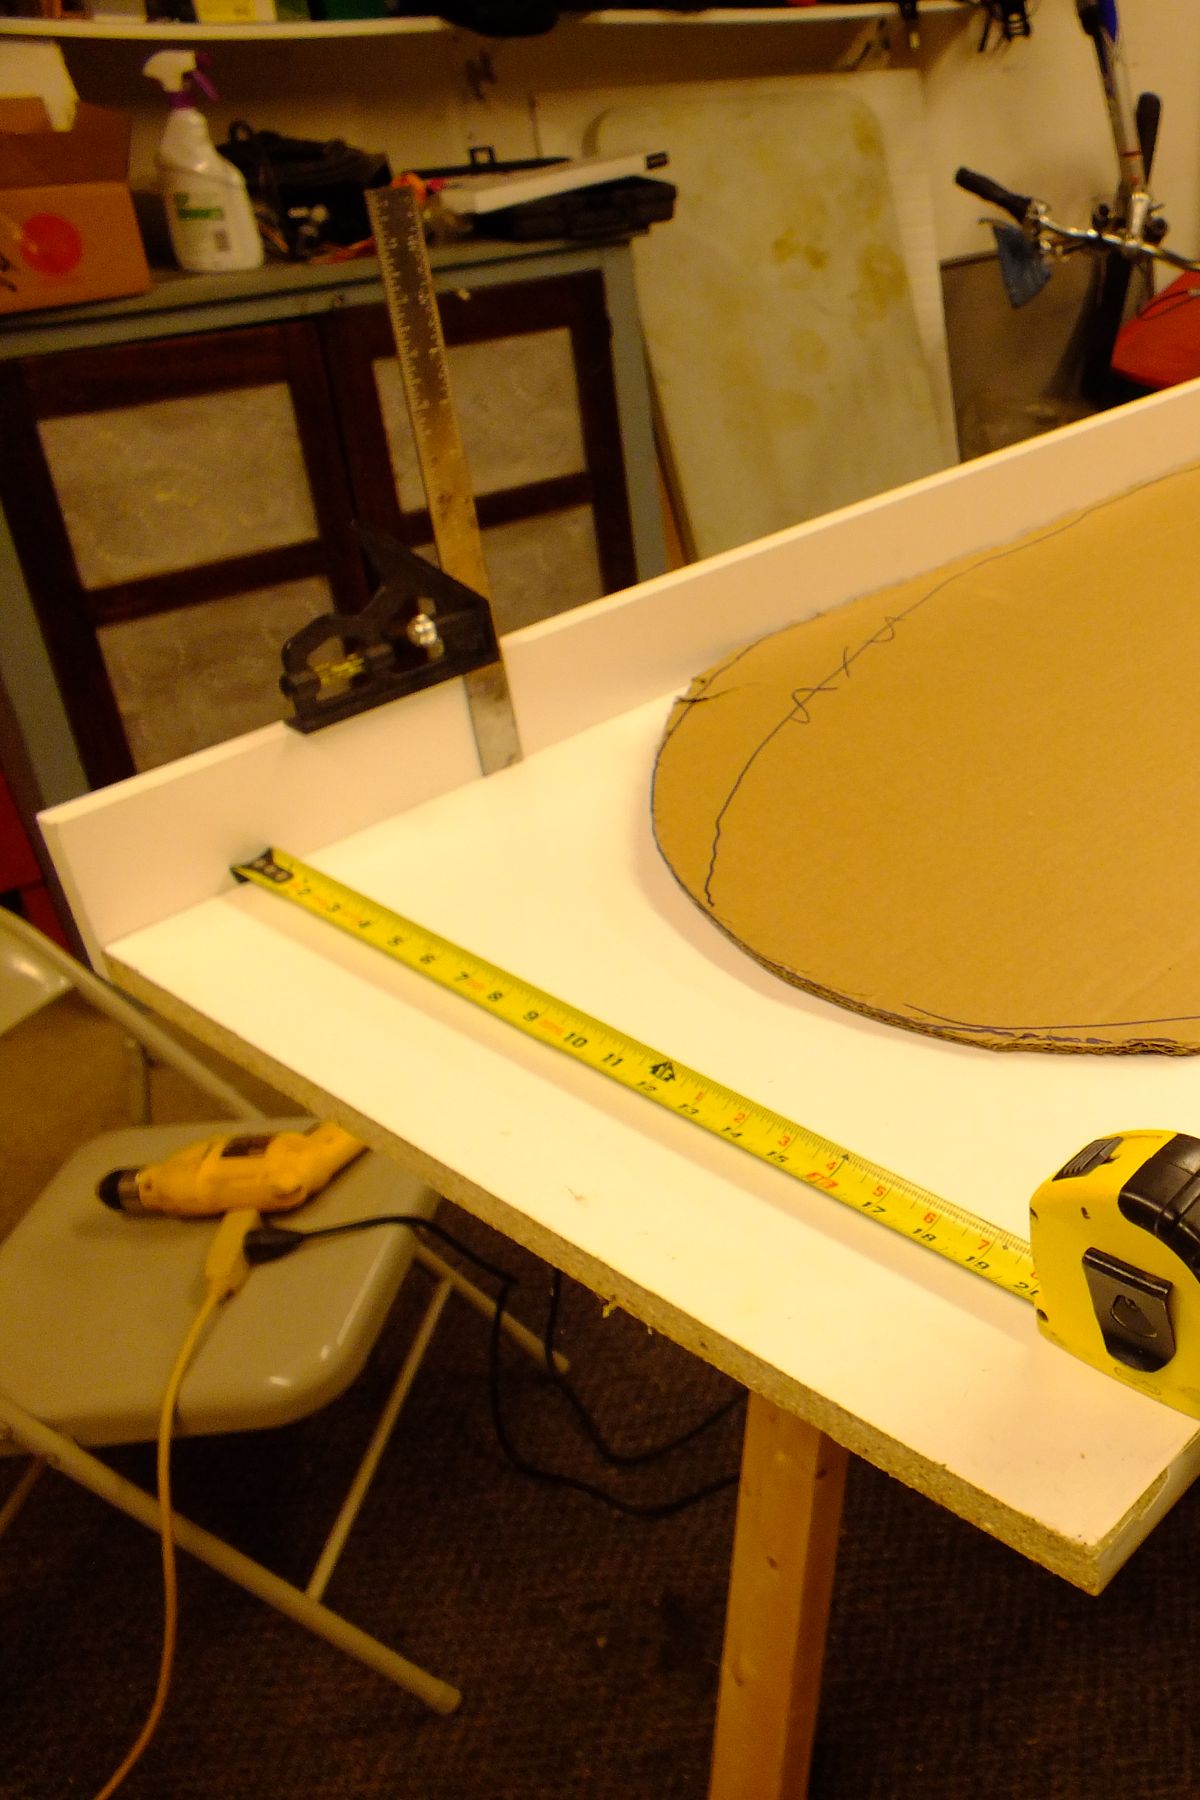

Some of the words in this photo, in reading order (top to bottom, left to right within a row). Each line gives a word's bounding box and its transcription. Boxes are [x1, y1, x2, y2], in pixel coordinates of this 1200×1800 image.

[453, 970, 469, 981] 7
[487, 990, 503, 1002] 8
[523, 1009, 539, 1022] 9
[563, 1031, 588, 1048] 10
[602, 1052, 623, 1067] 11
[721, 1126, 743, 1139] 14
[766, 1150, 789, 1163] 15
[861, 1200, 886, 1214] 17
[911, 1227, 937, 1243] 18
[964, 1255, 989, 1271] 19
[732, 1111, 746, 1124] 2
[777, 1133, 791, 1148] 3
[872, 1184, 886, 1198] 5
[922, 1211, 937, 1224] 6
[976, 1238, 990, 1251] 7
